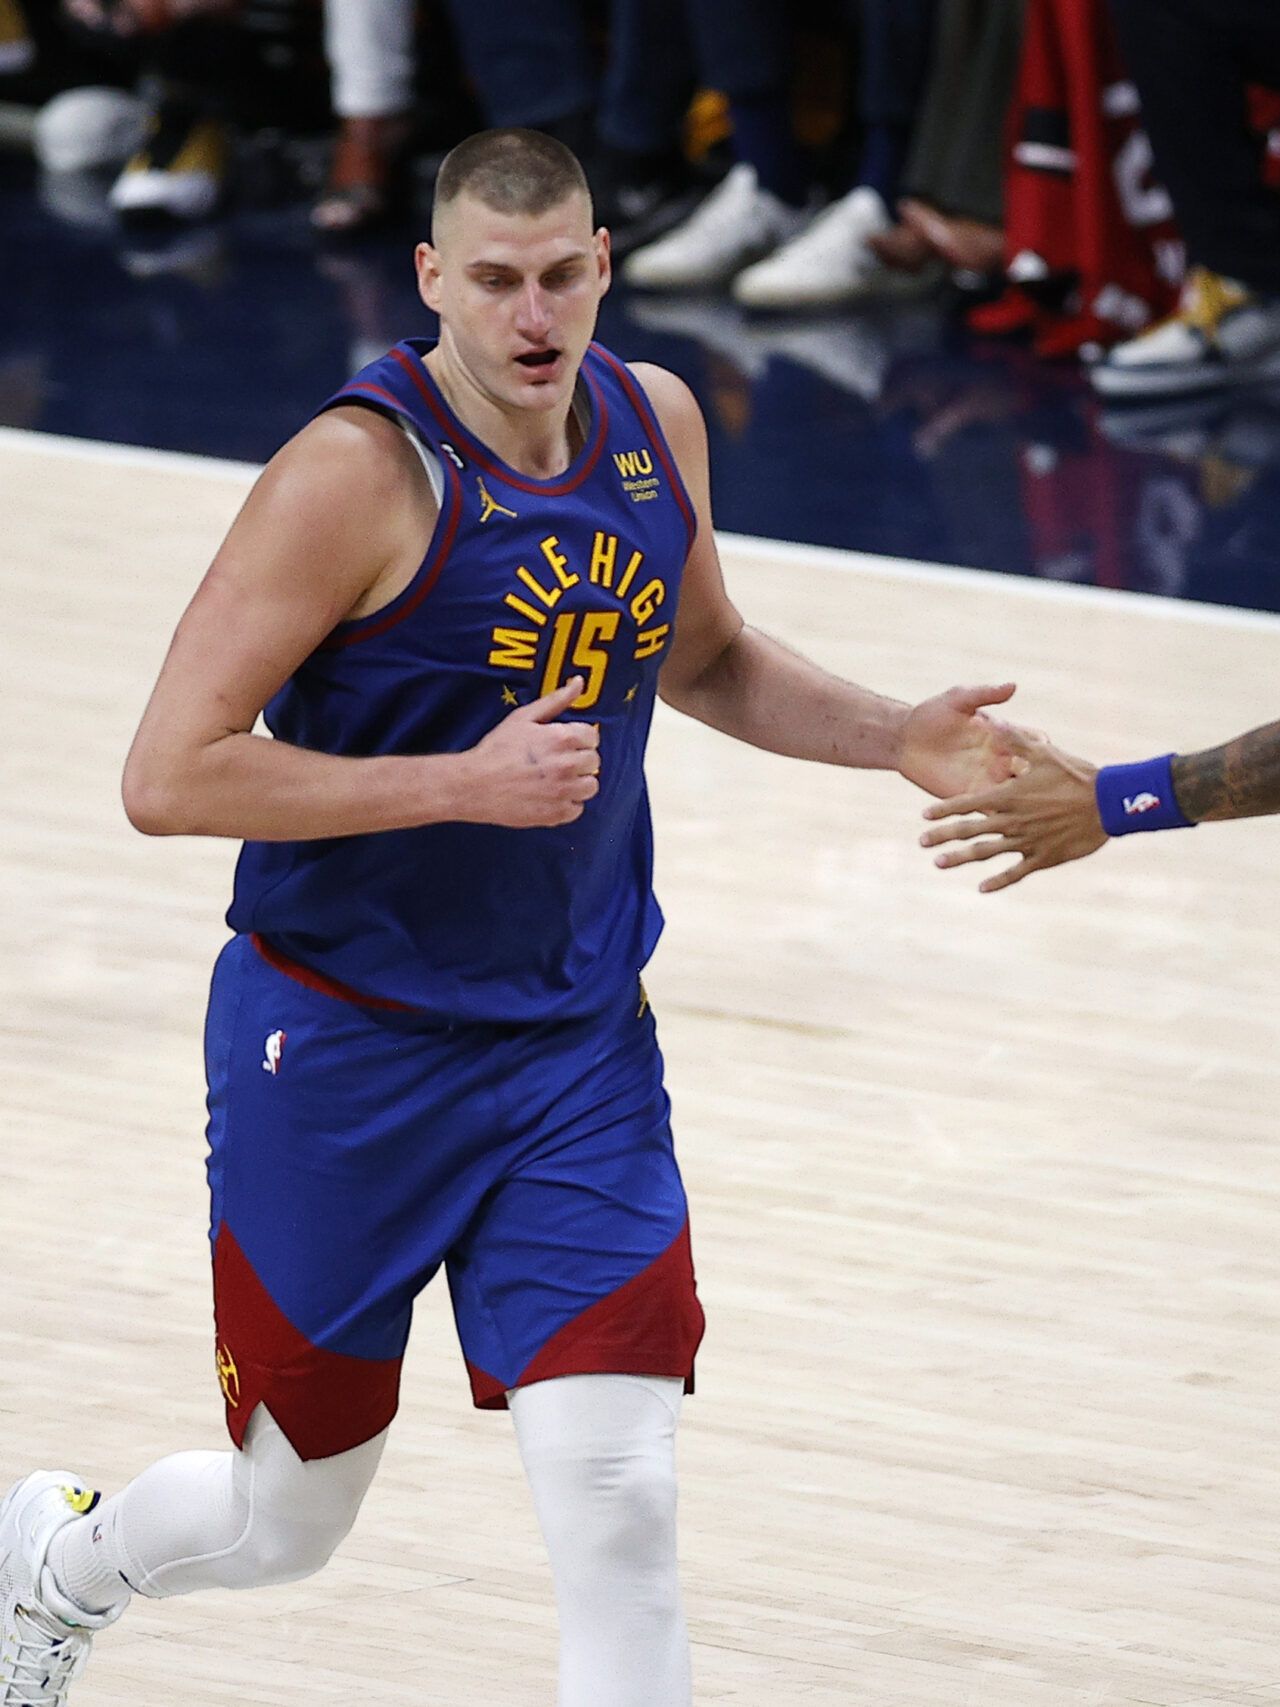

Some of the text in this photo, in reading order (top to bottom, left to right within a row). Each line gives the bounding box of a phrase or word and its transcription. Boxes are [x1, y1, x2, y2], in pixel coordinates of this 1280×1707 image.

[612, 449, 653, 478] WU
[488, 531, 670, 670] MILE HIGH
[540, 611, 621, 710] 15
